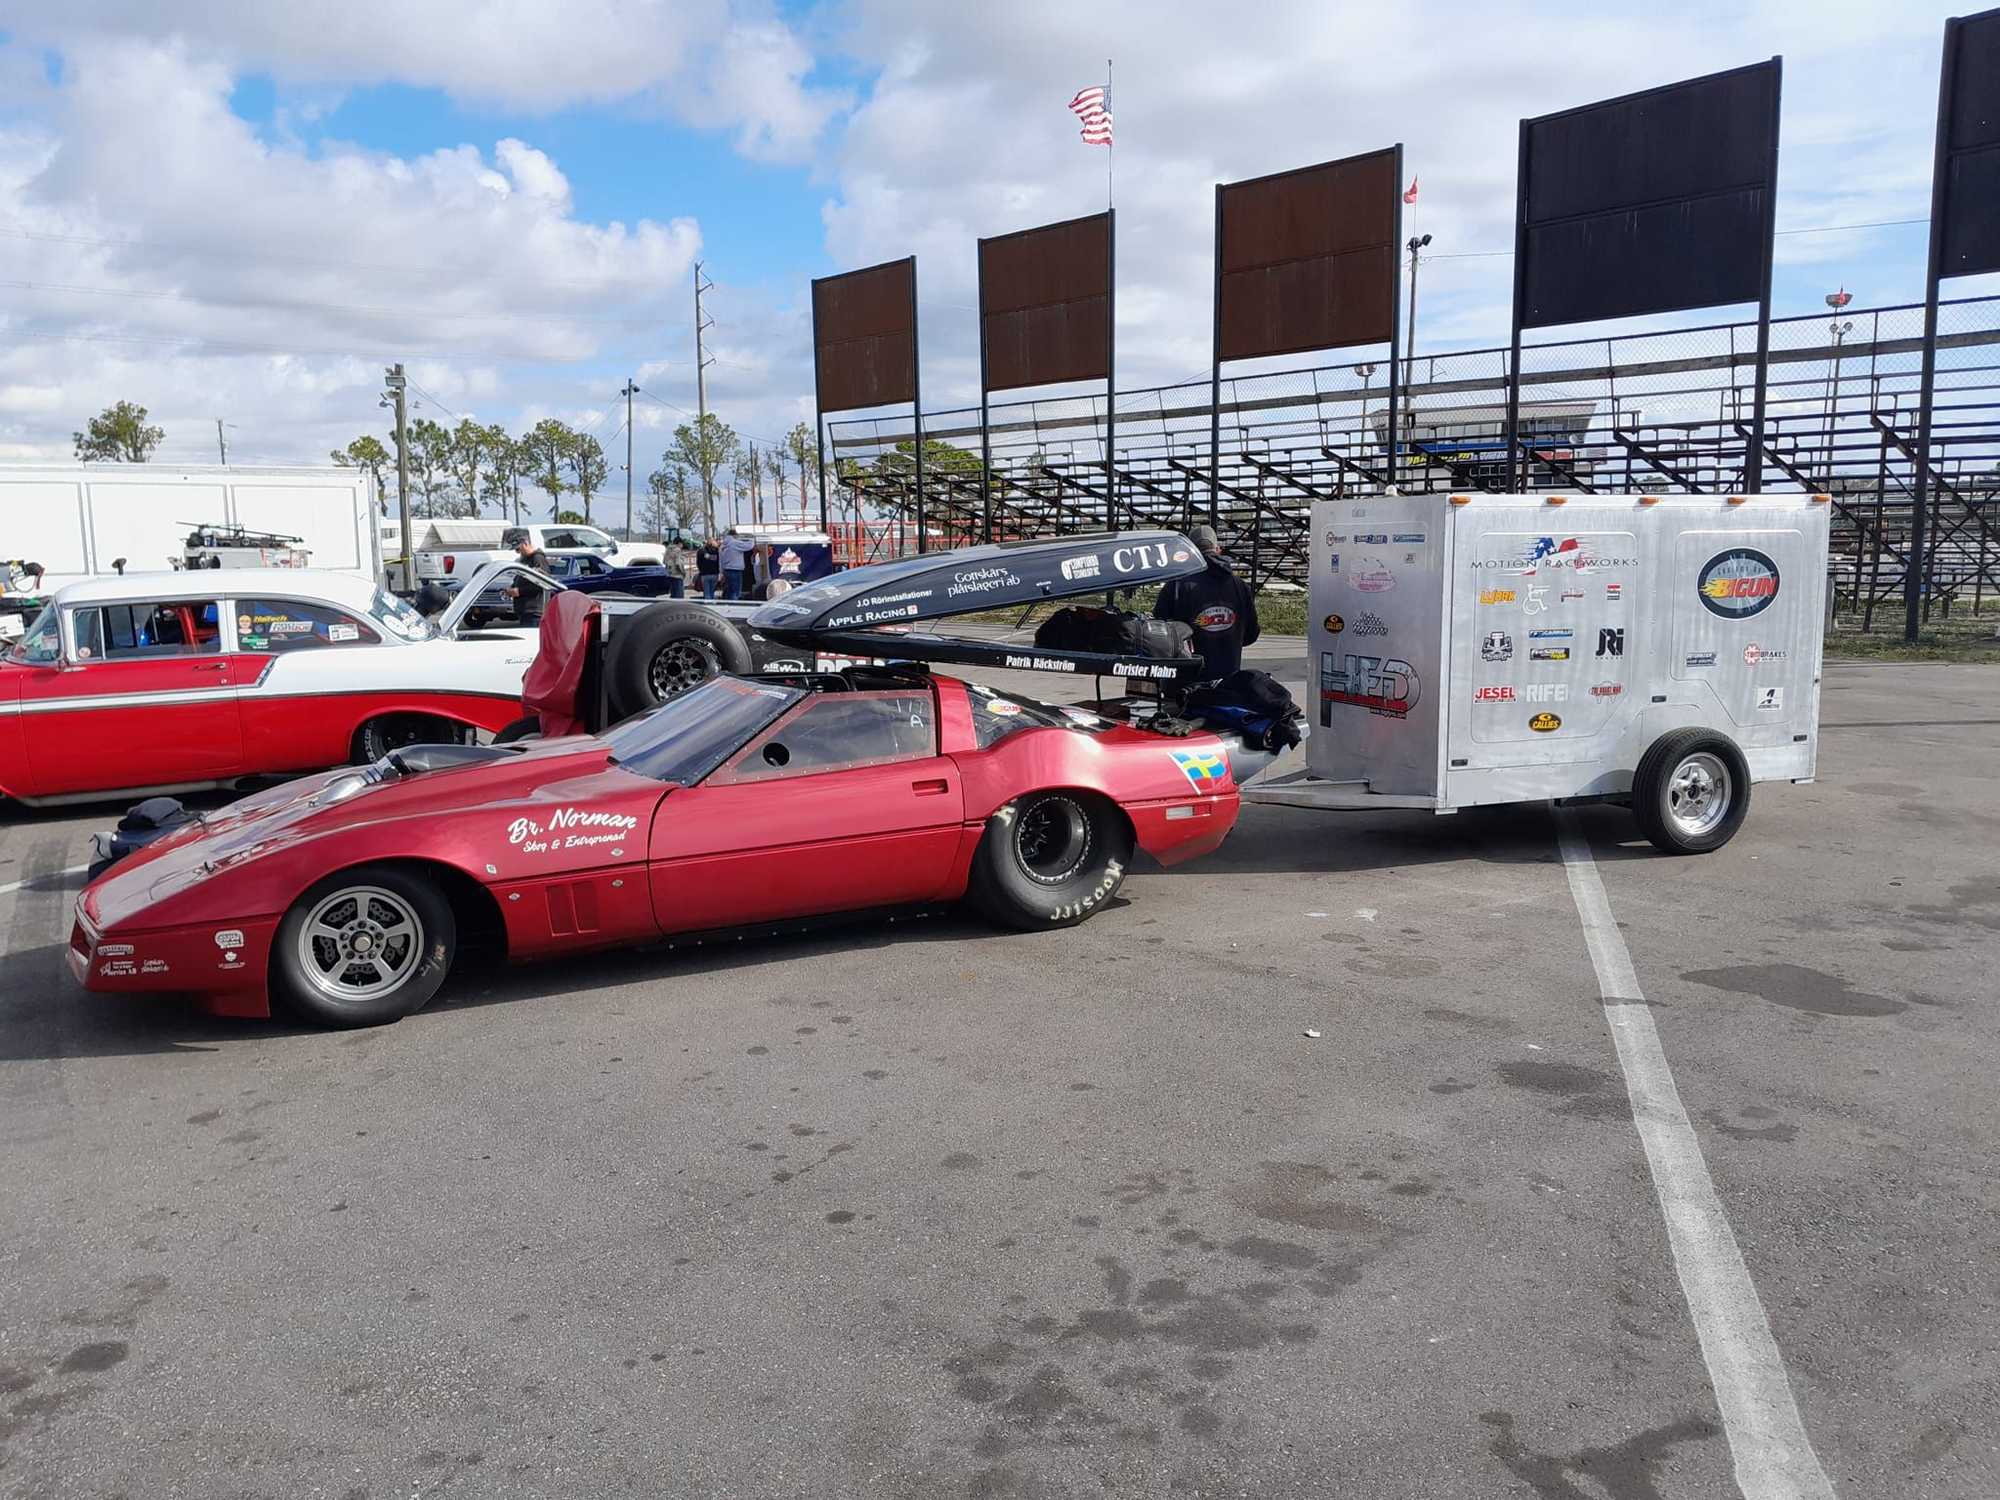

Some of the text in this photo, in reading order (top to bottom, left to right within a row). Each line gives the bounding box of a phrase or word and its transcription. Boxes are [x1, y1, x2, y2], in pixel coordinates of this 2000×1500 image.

[1113, 543, 1169, 573] CTJ
[1470, 558, 1639, 569] MOTION RACEWORKS
[1714, 576, 1777, 599] BIGUN
[856, 598, 870, 608] J.O
[828, 608, 906, 628] APPLE RACING
[1005, 655, 1076, 672] Patrik Bäckström
[1113, 662, 1177, 679] Christer Mahrs
[1475, 686, 1516, 699] JESEL
[1532, 720, 1560, 729] CALLIES
[507, 807, 638, 844] Br. Norman
[551, 839, 560, 850] &
